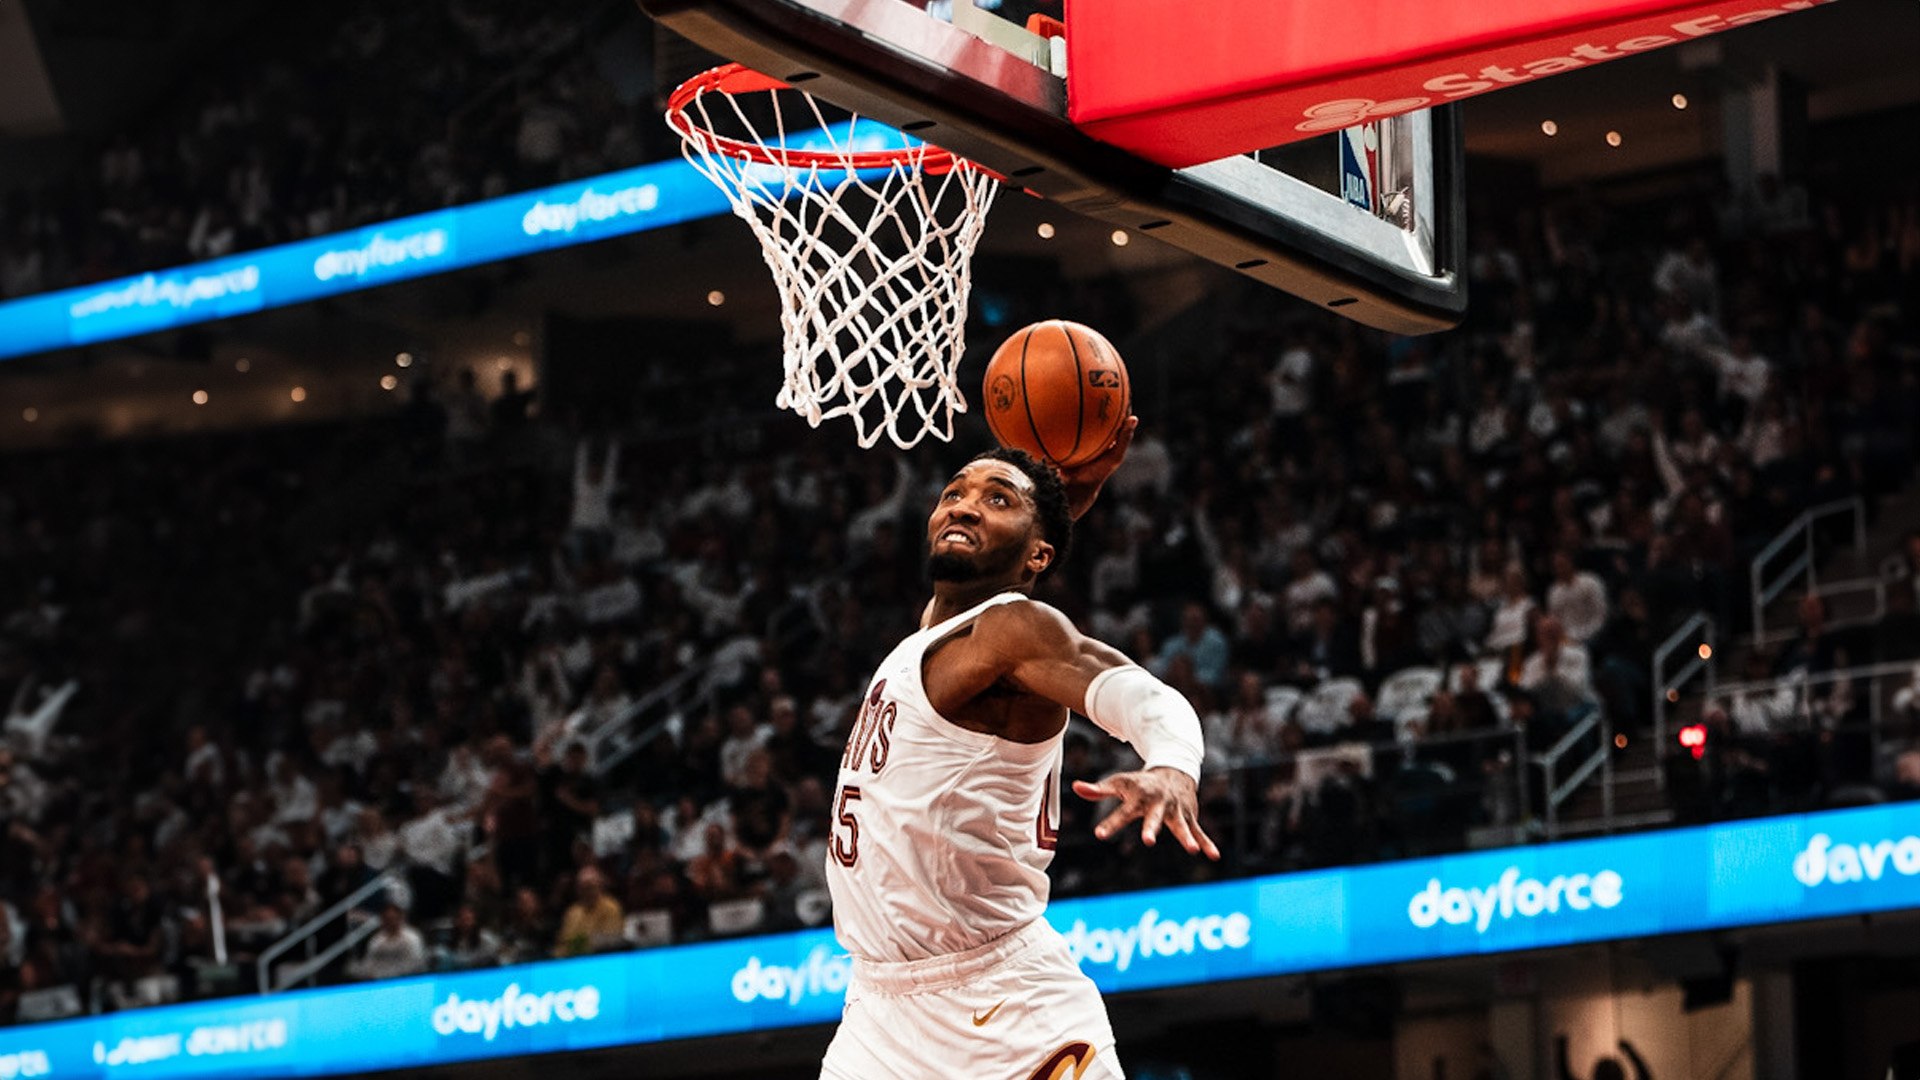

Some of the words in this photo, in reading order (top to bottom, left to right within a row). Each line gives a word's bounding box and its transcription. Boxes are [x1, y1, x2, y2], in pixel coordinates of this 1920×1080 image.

[1423, 35, 1679, 98] State
[1670, 0, 1840, 36] Fa
[828, 784, 862, 868] 5
[1408, 867, 1624, 933] dayforce
[1064, 908, 1251, 972] dayforce
[432, 983, 600, 1041] dayforce
